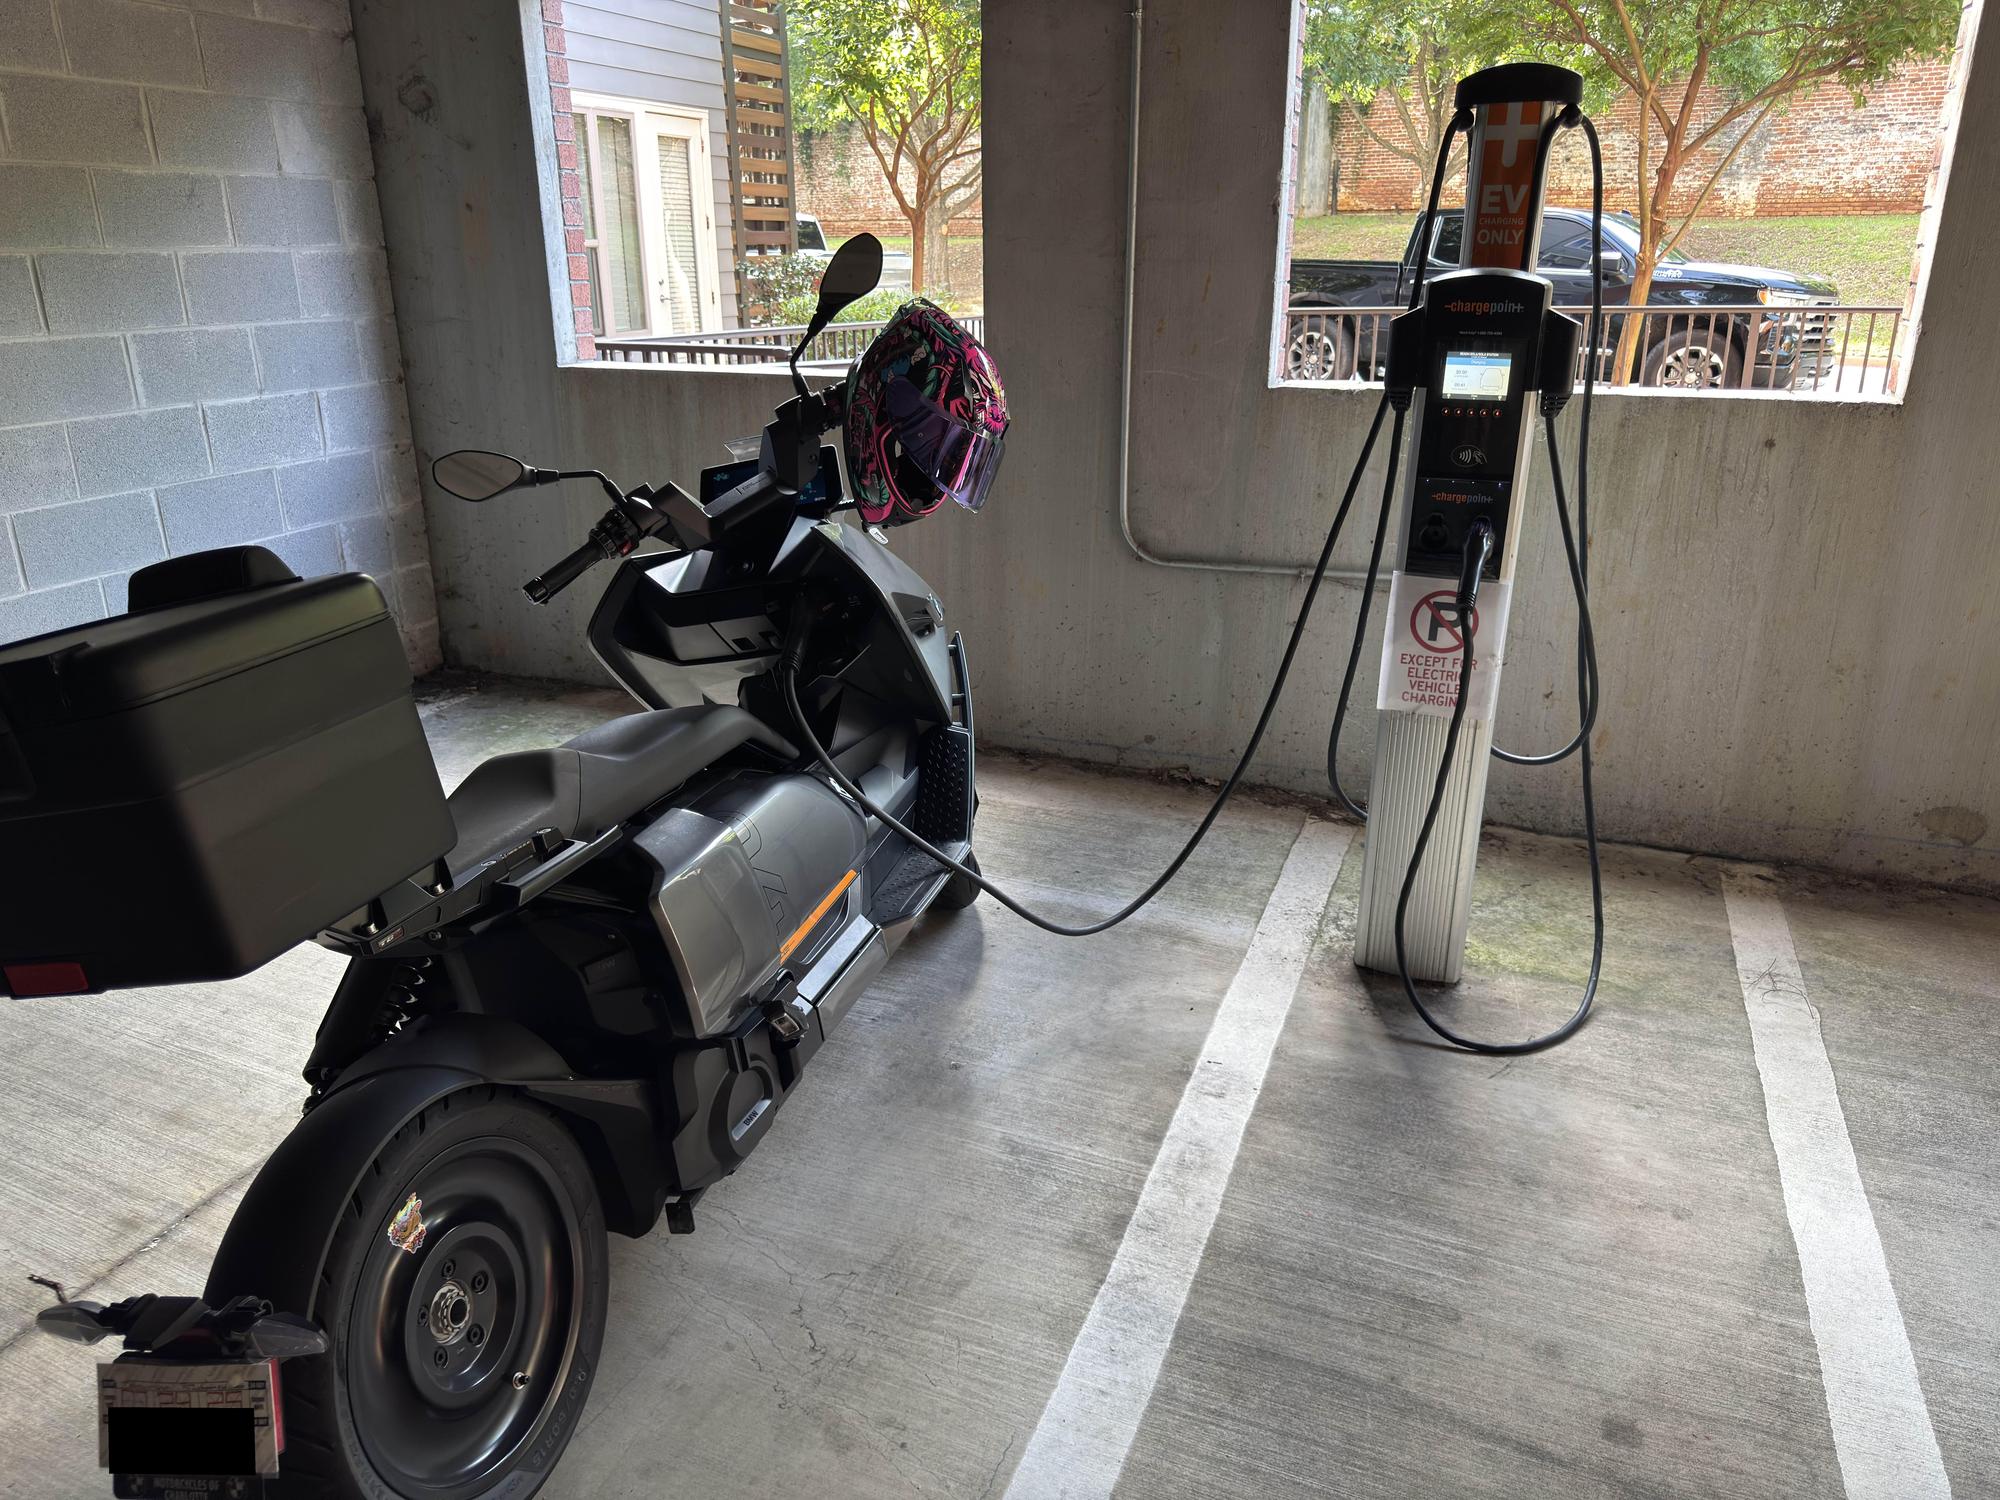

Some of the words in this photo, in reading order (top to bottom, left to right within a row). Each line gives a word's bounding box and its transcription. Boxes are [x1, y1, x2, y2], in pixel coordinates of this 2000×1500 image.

[1481, 184, 1529, 214] EV
[1479, 217, 1524, 226] CHARGING
[1477, 229, 1523, 245] ONLY
[1400, 653, 1448, 668] EXCEPT
[1452, 657, 1478, 671] FR
[1407, 667, 1461, 682] ELECTRI
[1402, 691, 1458, 707] CHARGIN
